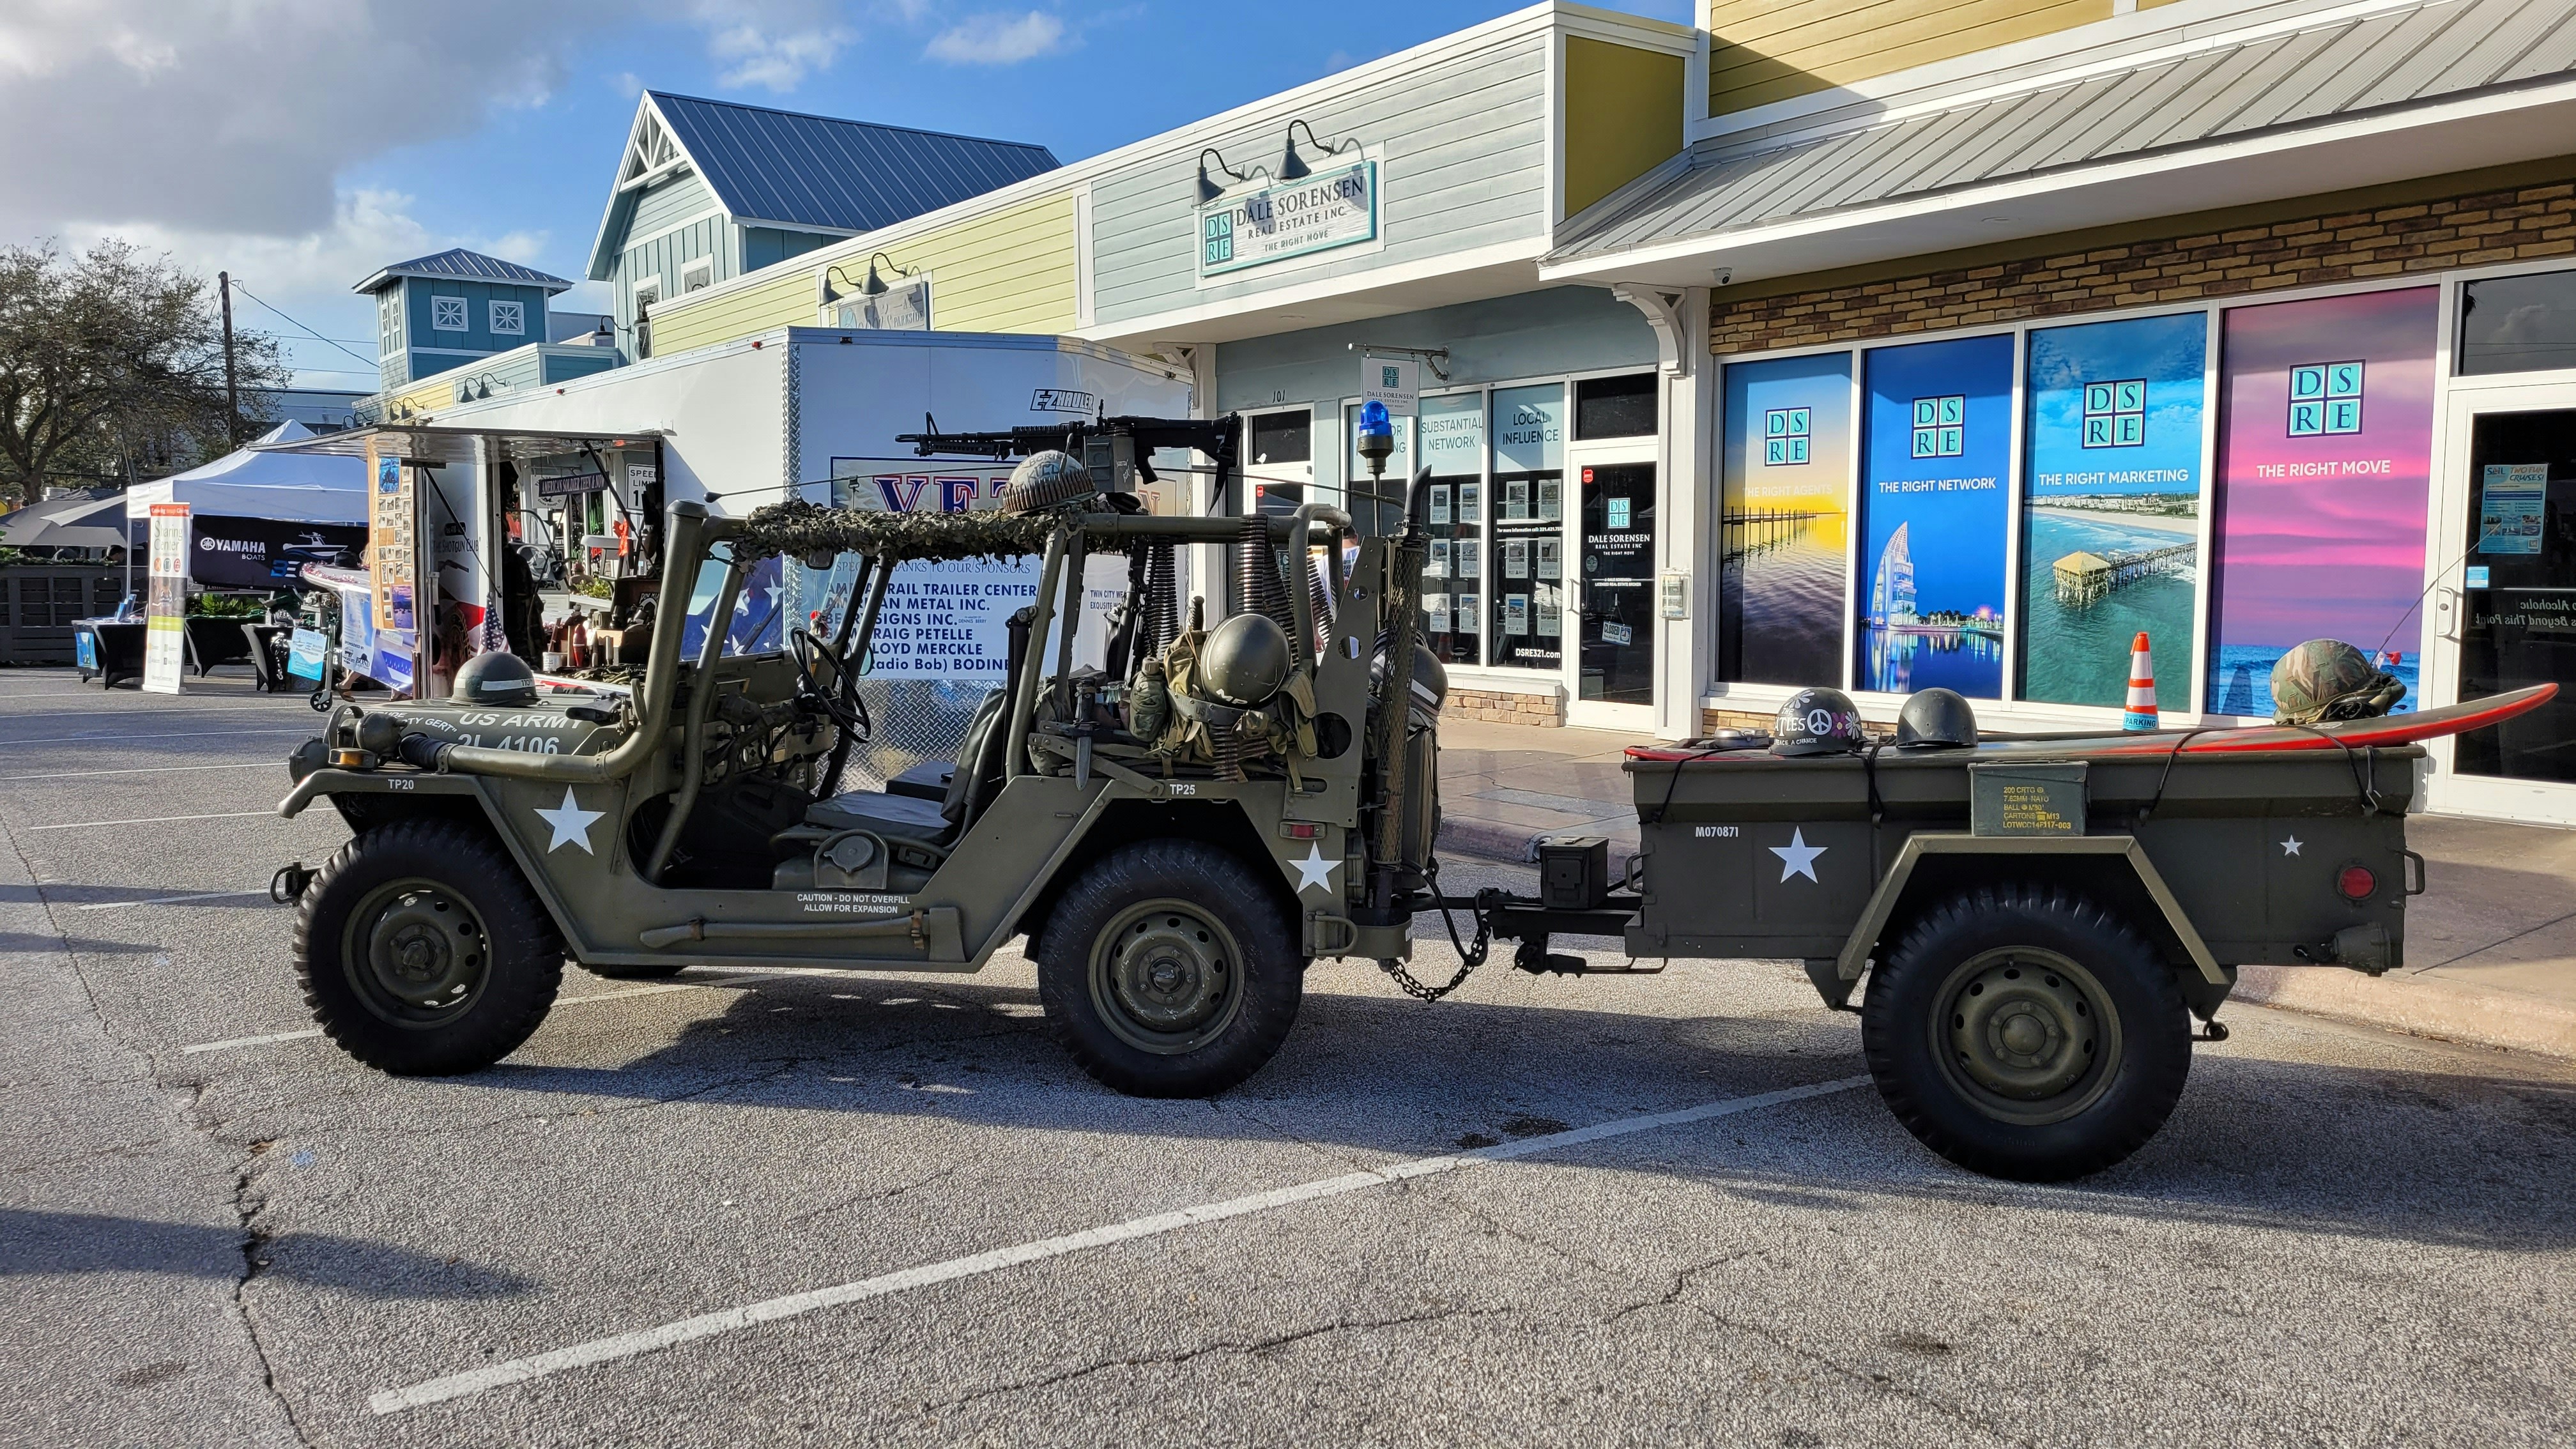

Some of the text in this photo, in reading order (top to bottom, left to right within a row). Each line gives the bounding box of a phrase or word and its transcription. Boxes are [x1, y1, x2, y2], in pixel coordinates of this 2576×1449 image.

[1236, 176, 1363, 226] DALE SORENSEN
[1248, 225, 1273, 240] REAL
[1279, 213, 1319, 231] ESTATE
[1264, 242, 1278, 252] THE
[1281, 236, 1303, 247] RIGHT
[894, 310, 924, 327] PARKSIDE
[1422, 417, 1483, 434] SUBSTANTIAL
[1513, 411, 1548, 426] LOCAL
[1428, 435, 1476, 451] NETWORK
[1502, 429, 1559, 445] INFLUENCE
[631, 469, 656, 478] SPEE
[2256, 459, 2391, 478] THE RIGHT MOVE
[2039, 469, 2189, 486] THE RIGHT MARKETING
[542, 479, 562, 494] AMERICAN
[563, 477, 580, 492] SOLDIER
[580, 476, 590, 490] THEN
[1743, 484, 1833, 497] THE RIGHT AGENTS
[1879, 477, 1997, 493] THE RIGHT NETWORK
[154, 520, 183, 541] Sharing
[154, 538, 180, 551] Center
[1588, 534, 1650, 543] DALE SORENSEN
[215, 539, 266, 553] YAMAHA
[442, 540, 466, 553] SHOTGUN
[466, 539, 479, 552] CLUB
[931, 563, 1031, 574] TO OUR SPONSORS
[923, 583, 979, 596] TRAILER
[985, 584, 1037, 597] CENTER
[1090, 590, 1116, 599] TWIN CITY
[907, 598, 990, 611] METAL INC.
[876, 613, 958, 625] SIGNS INC.
[873, 627, 973, 640] RAIG PETELLE
[1604, 623, 1620, 636] CLOSED
[917, 643, 983, 656] MERCKLE
[1515, 648, 1561, 659] DSRE321.com
[914, 657, 948, 673] Bob)
[1216, 688, 1248, 705] MP
[459, 712, 583, 730] US ARMY
[2126, 717, 2156, 727] PARKING
[388, 779, 415, 790] TP20
[1169, 783, 1195, 795] TP25
[1695, 826, 1739, 838] M070871
[797, 894, 832, 902] CAUTION
[871, 896, 910, 904] OVERFILL
[853, 905, 898, 914] EXPANSION
